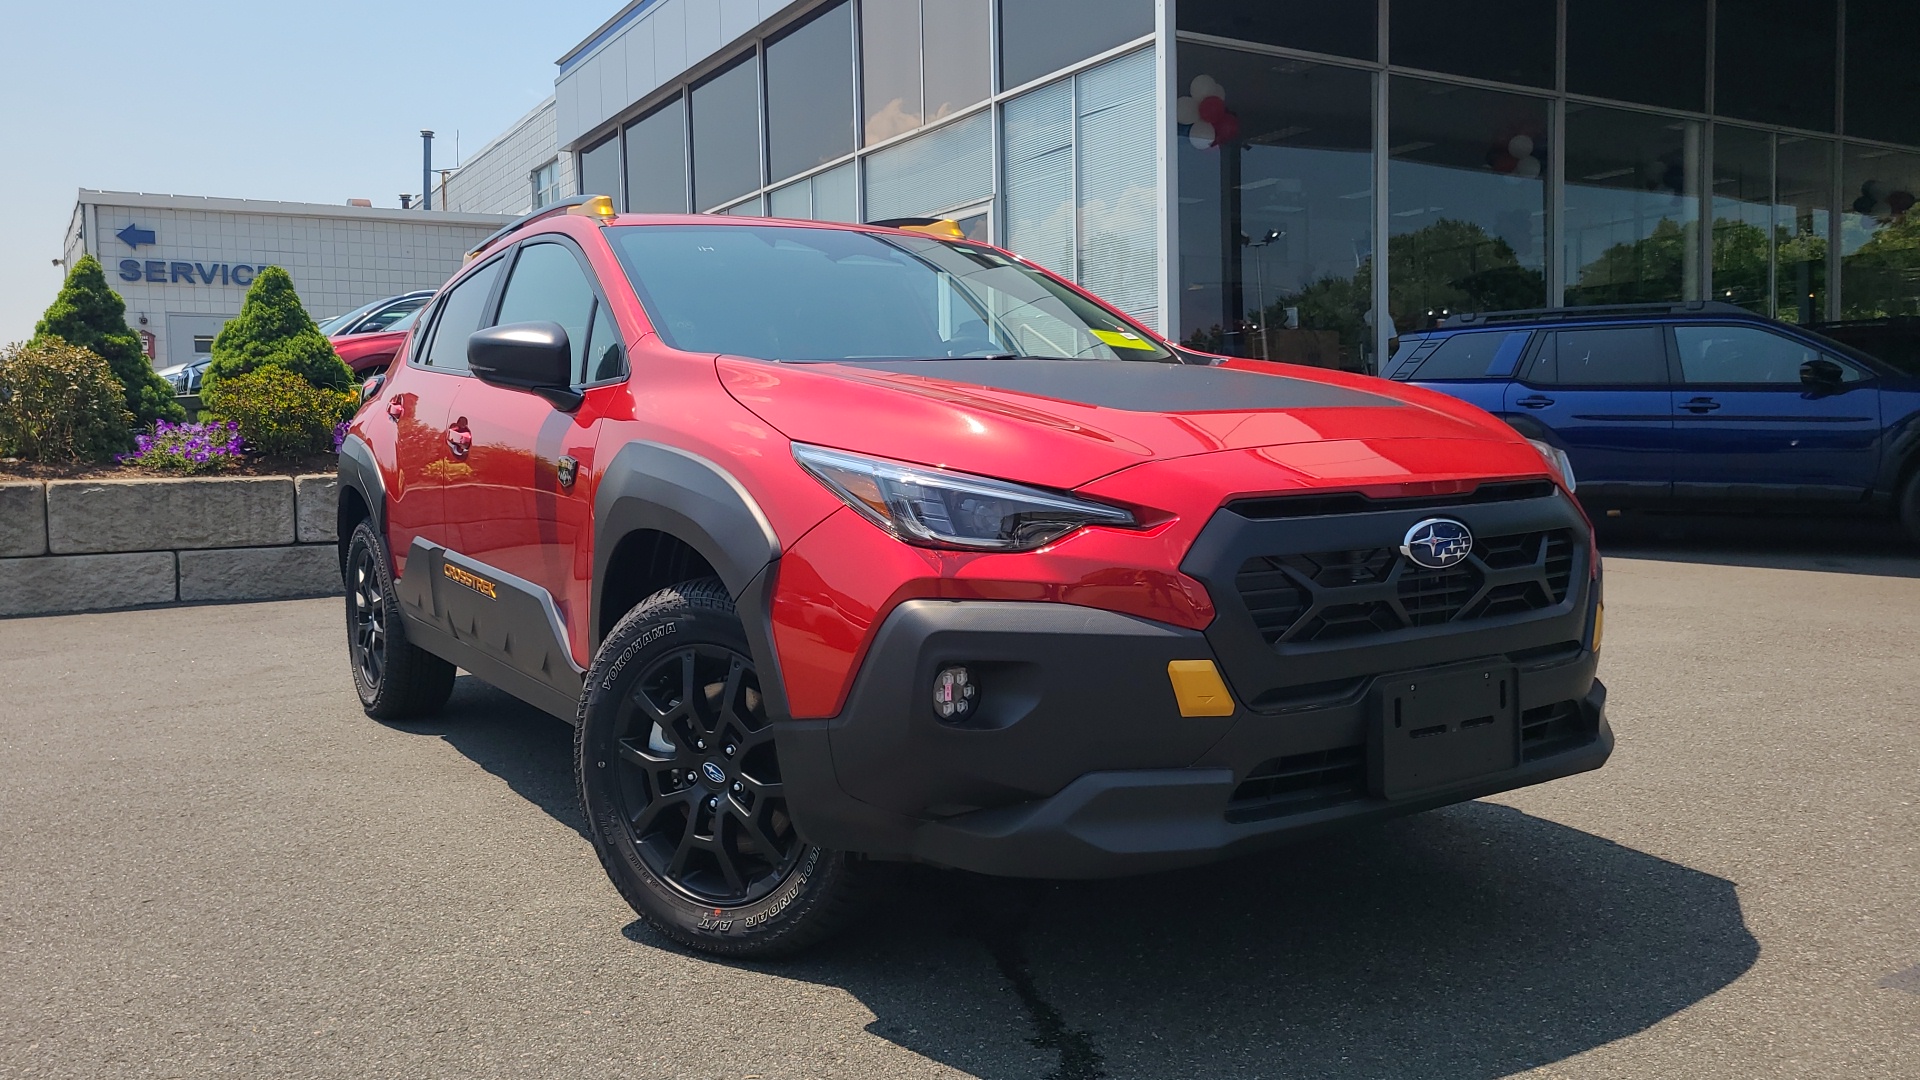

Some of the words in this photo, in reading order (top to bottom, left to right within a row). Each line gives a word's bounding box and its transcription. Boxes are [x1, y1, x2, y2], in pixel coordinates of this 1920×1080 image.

[119, 259, 267, 286] SERVIC
[443, 563, 497, 599] CROSSTREK
[601, 622, 676, 690] YOKOHAMA
[745, 846, 821, 928] EOLANDAR
